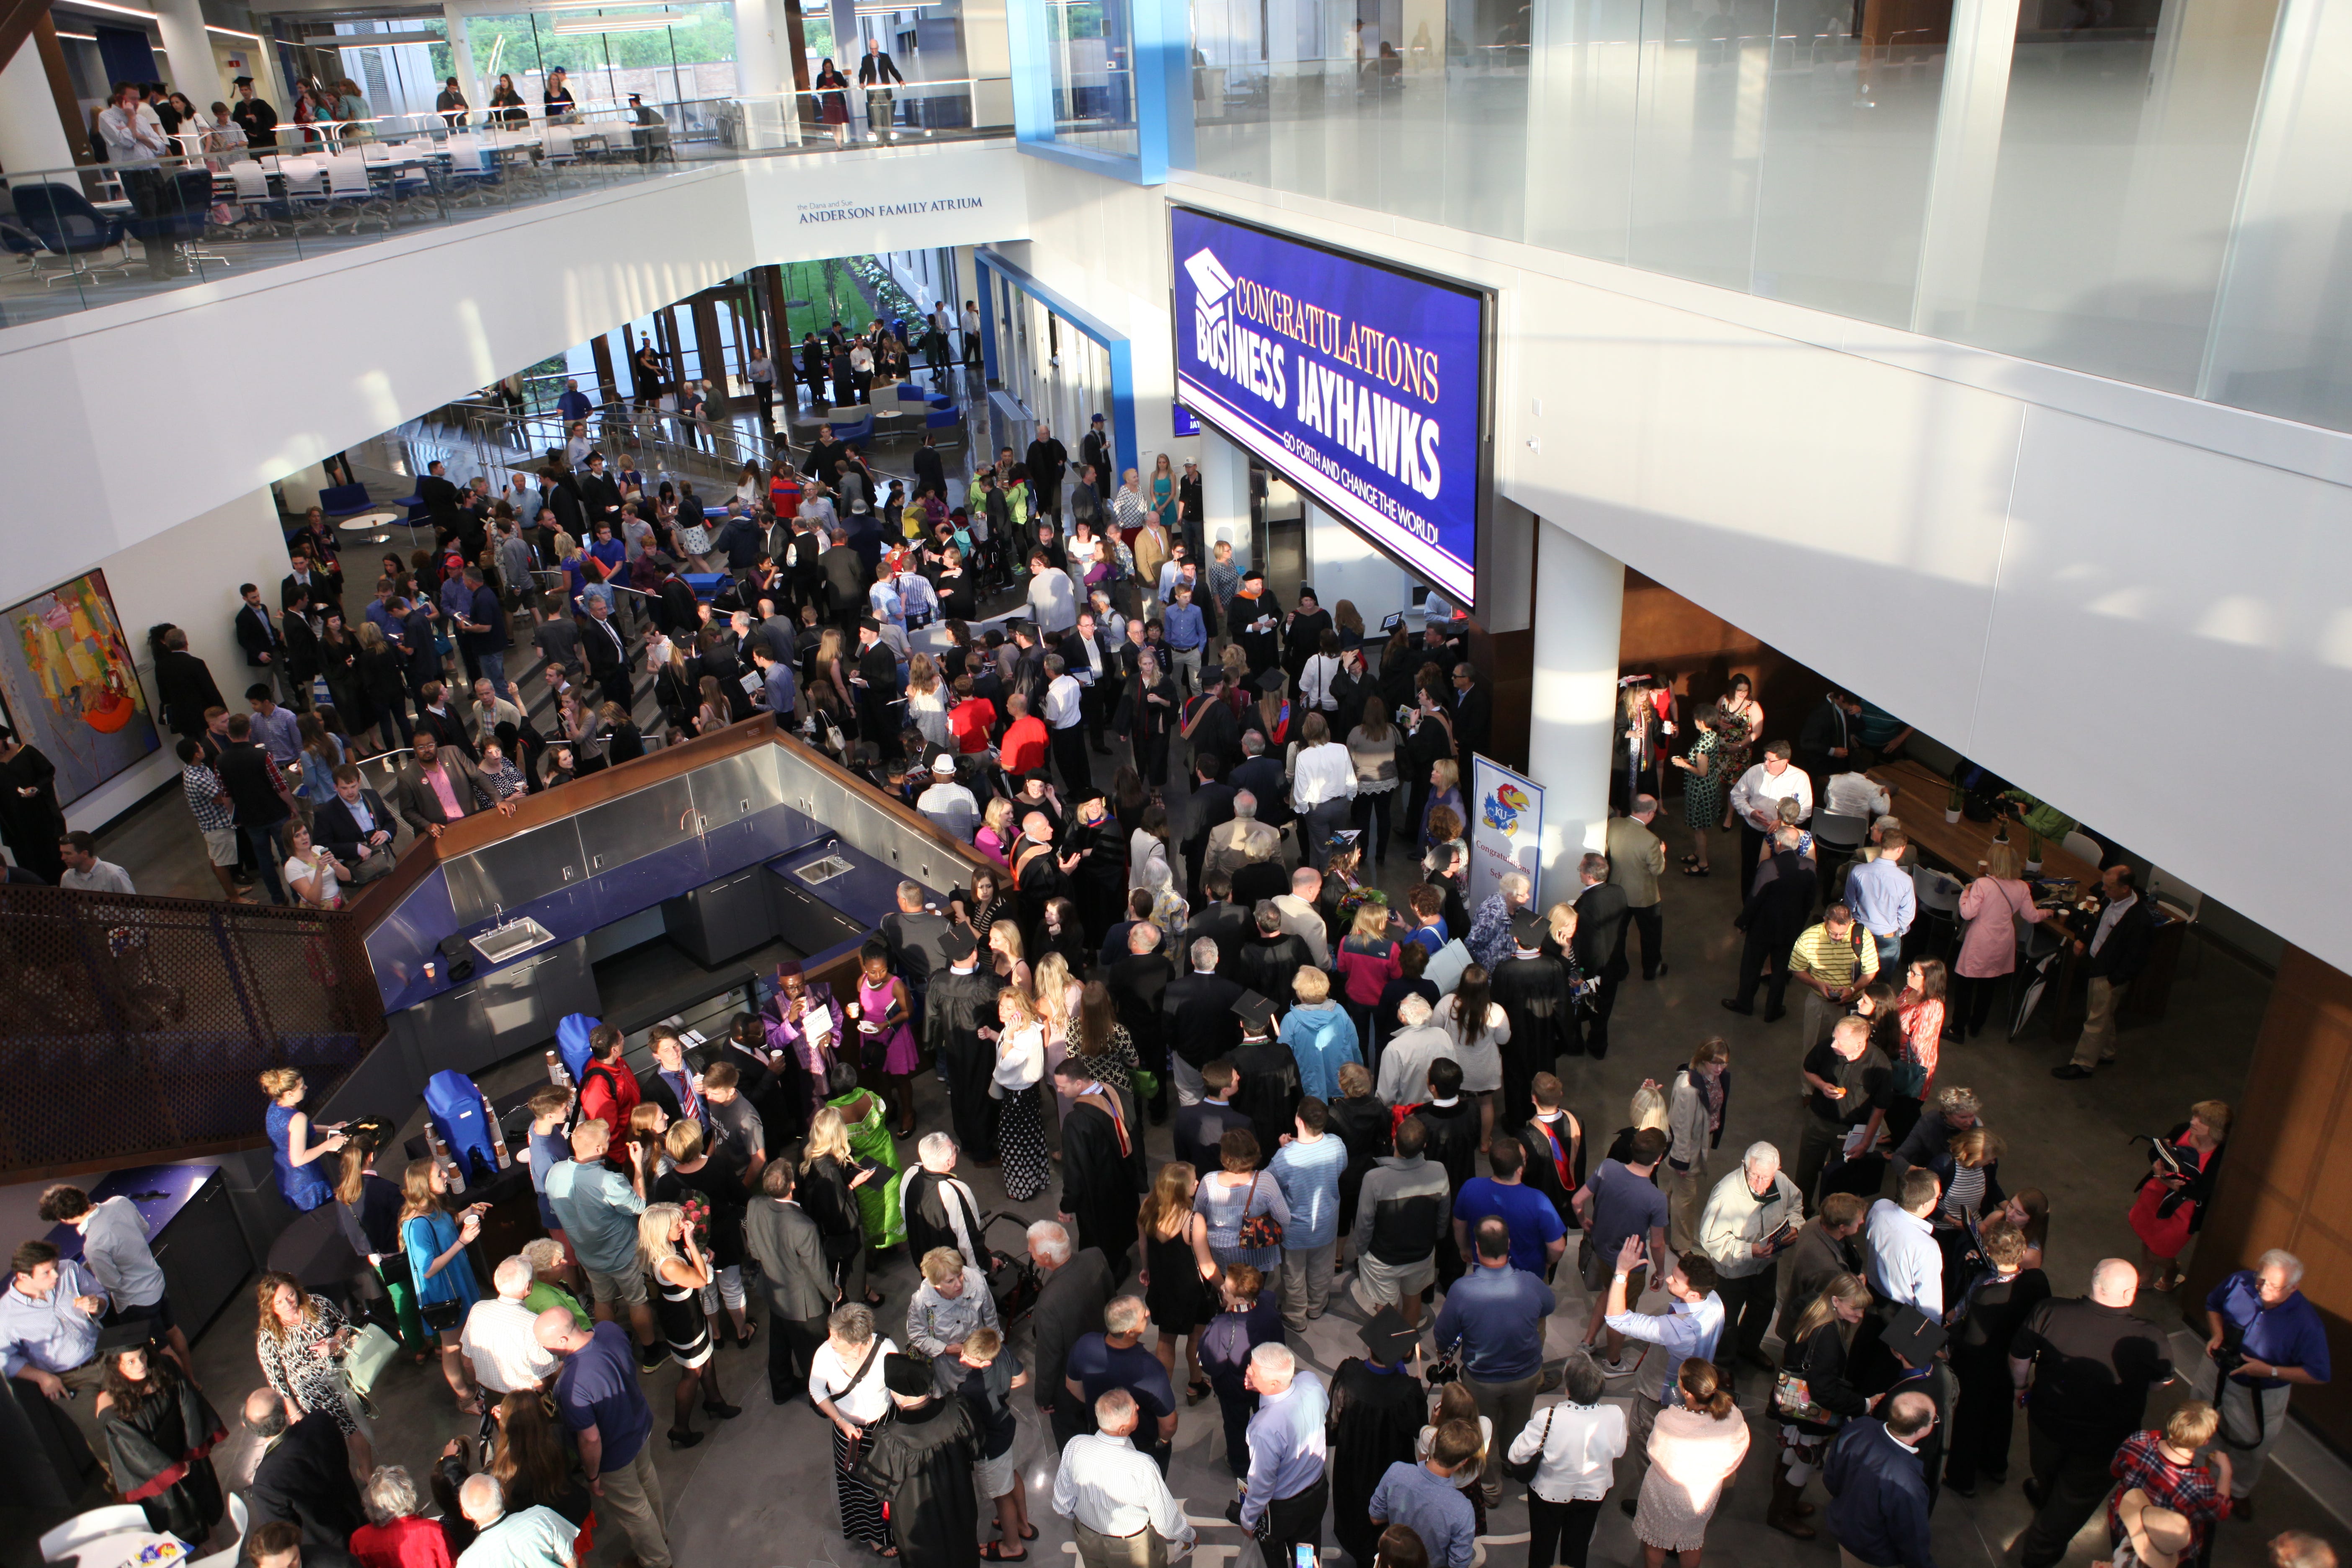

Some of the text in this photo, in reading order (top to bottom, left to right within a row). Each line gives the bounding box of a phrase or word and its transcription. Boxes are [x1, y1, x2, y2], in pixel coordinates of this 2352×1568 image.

[799, 197, 983, 224] ANDERSON FAMILY ATRIUM
[809, 201, 827, 209] Dana
[1236, 276, 1439, 404] CONGRATULATIONS
[1195, 297, 1440, 500] BUSINESS JAYHAWKS
[1284, 431, 1295, 451] GO
[1297, 439, 1320, 469] FORTH
[1322, 456, 1339, 481] AND
[1341, 469, 1378, 508] CHANGE
[1378, 491, 1397, 520] THE
[1495, 806, 1507, 820] KU
[1476, 839, 1530, 875] Congratulations
[1490, 868, 1502, 880] Sch
